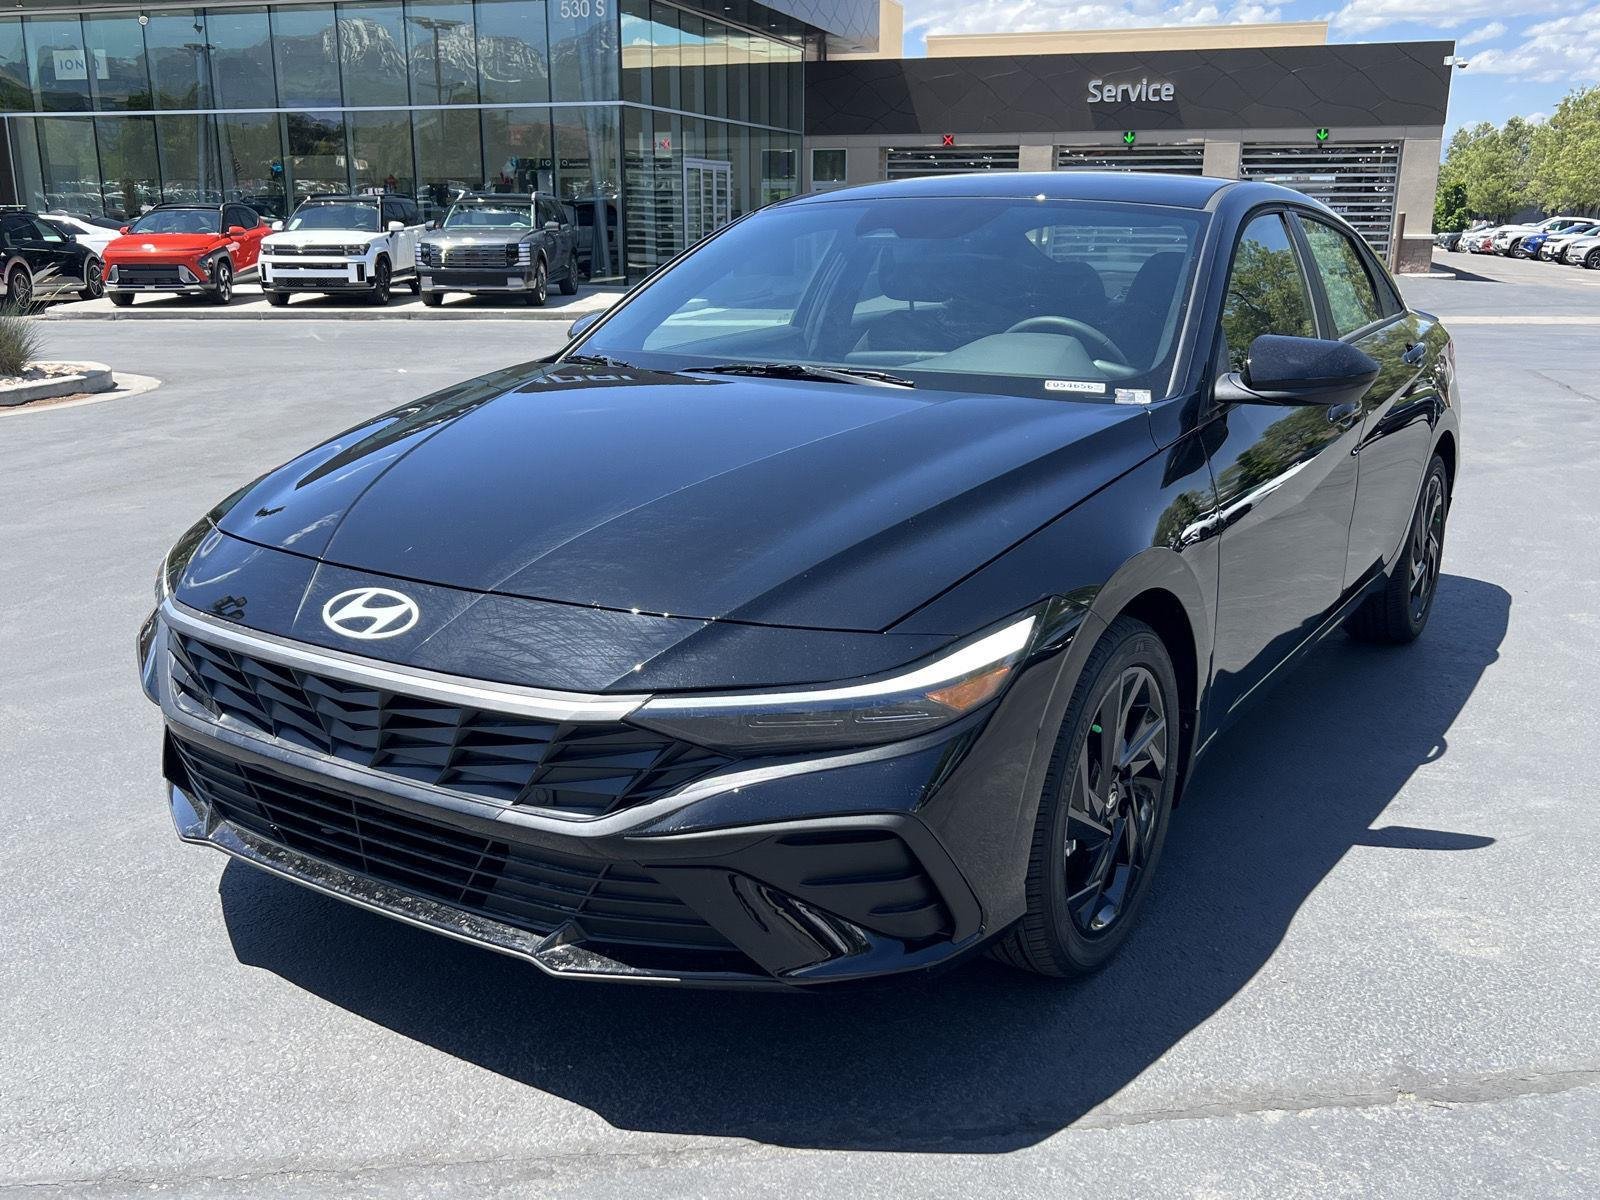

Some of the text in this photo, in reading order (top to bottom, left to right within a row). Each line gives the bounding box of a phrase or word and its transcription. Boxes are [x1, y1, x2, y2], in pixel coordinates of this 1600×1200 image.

[560, 0, 605, 18] 530 S
[1087, 77, 1175, 103] Service
